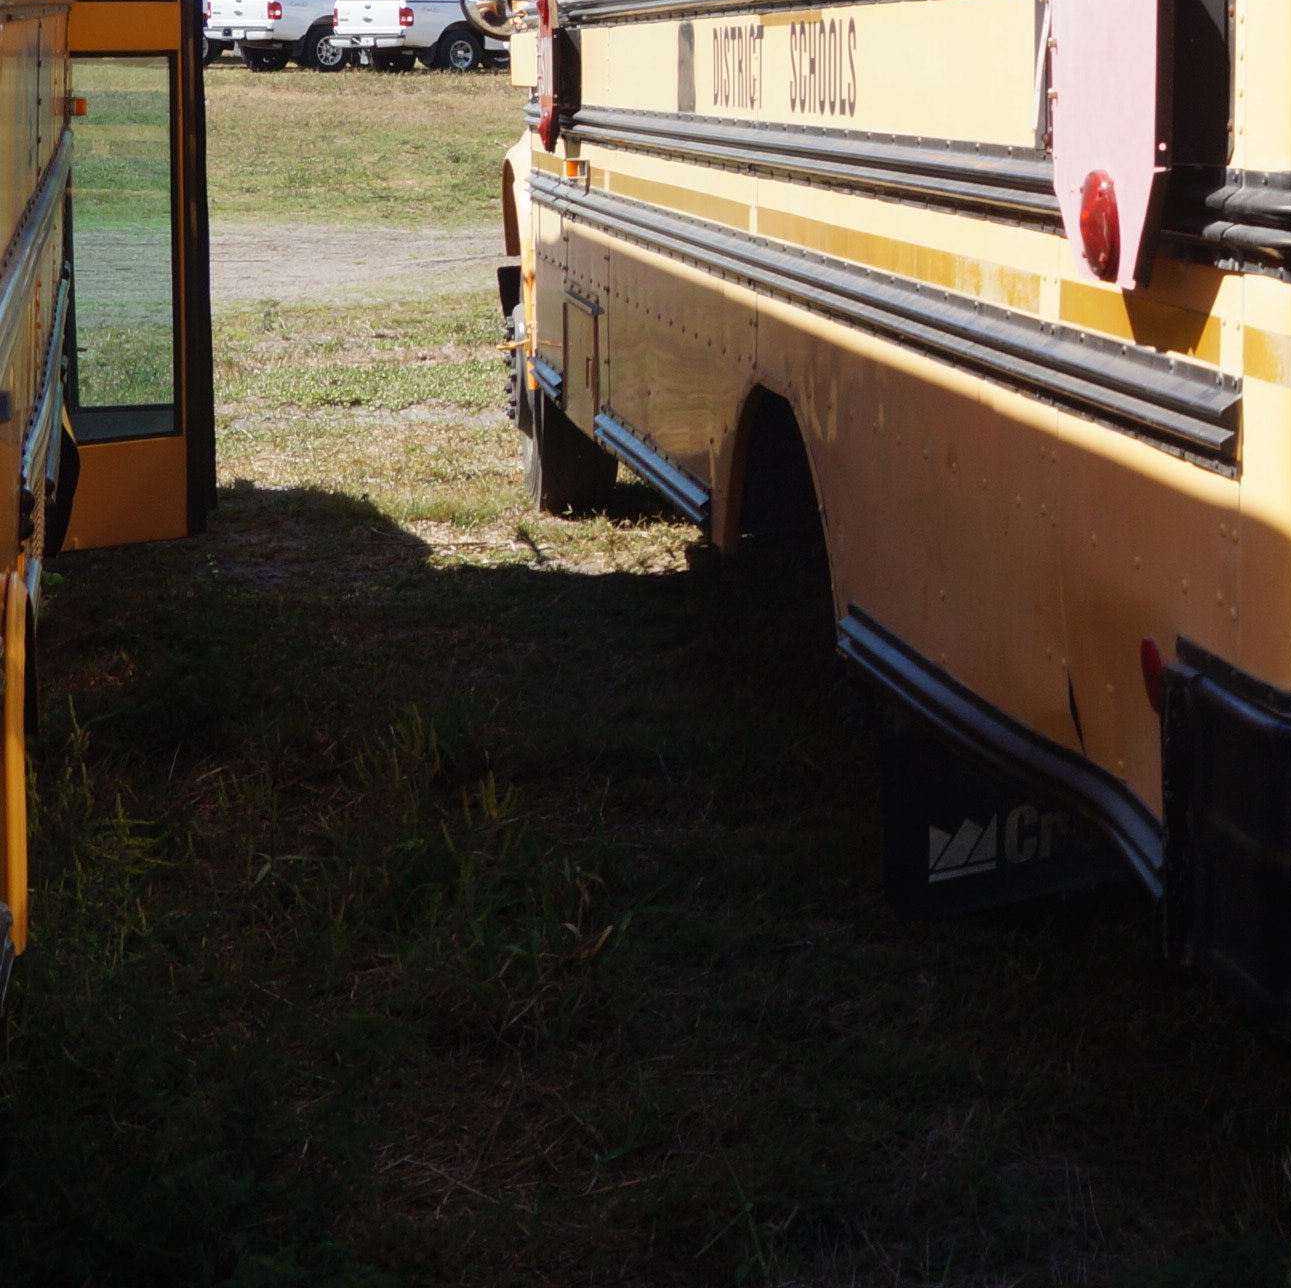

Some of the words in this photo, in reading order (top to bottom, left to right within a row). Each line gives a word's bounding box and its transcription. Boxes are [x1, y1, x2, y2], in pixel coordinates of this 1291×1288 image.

[713, 23, 765, 110] DISTRICT
[790, 16, 857, 117] SCHOOLS
[1005, 804, 1085, 864] Cr
